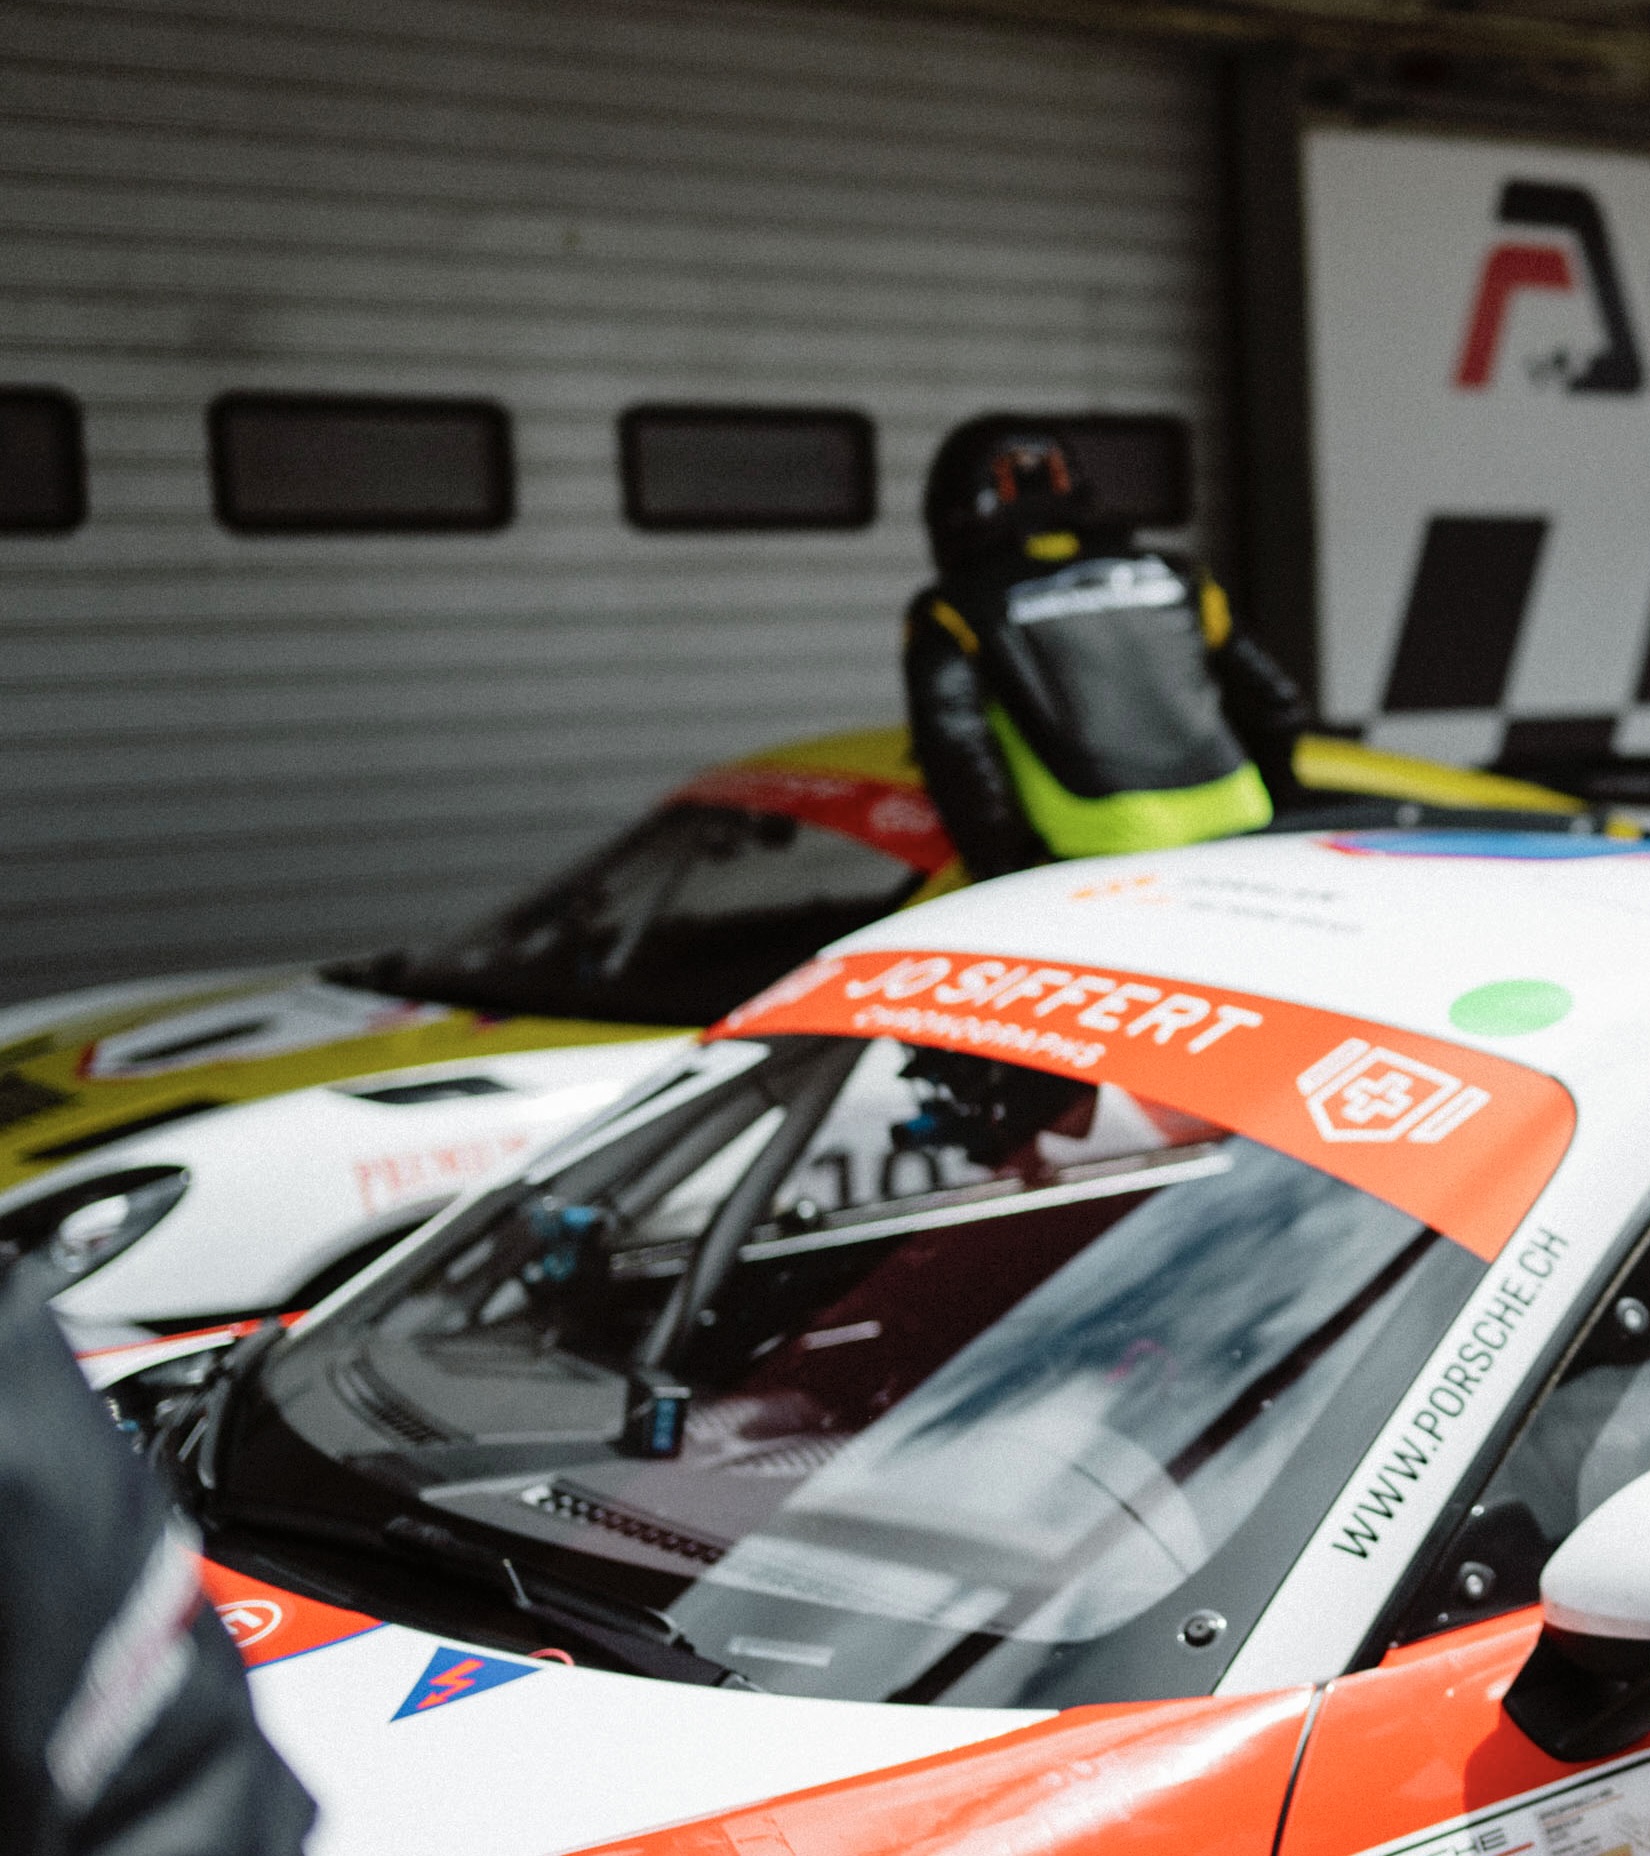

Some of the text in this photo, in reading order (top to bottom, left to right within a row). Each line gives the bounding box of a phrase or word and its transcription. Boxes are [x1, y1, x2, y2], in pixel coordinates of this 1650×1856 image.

[845, 956, 953, 1000] JO
[934, 958, 1264, 1055] SIFFERT
[1332, 1228, 1571, 1560] WWW.PORSCHE.CH
